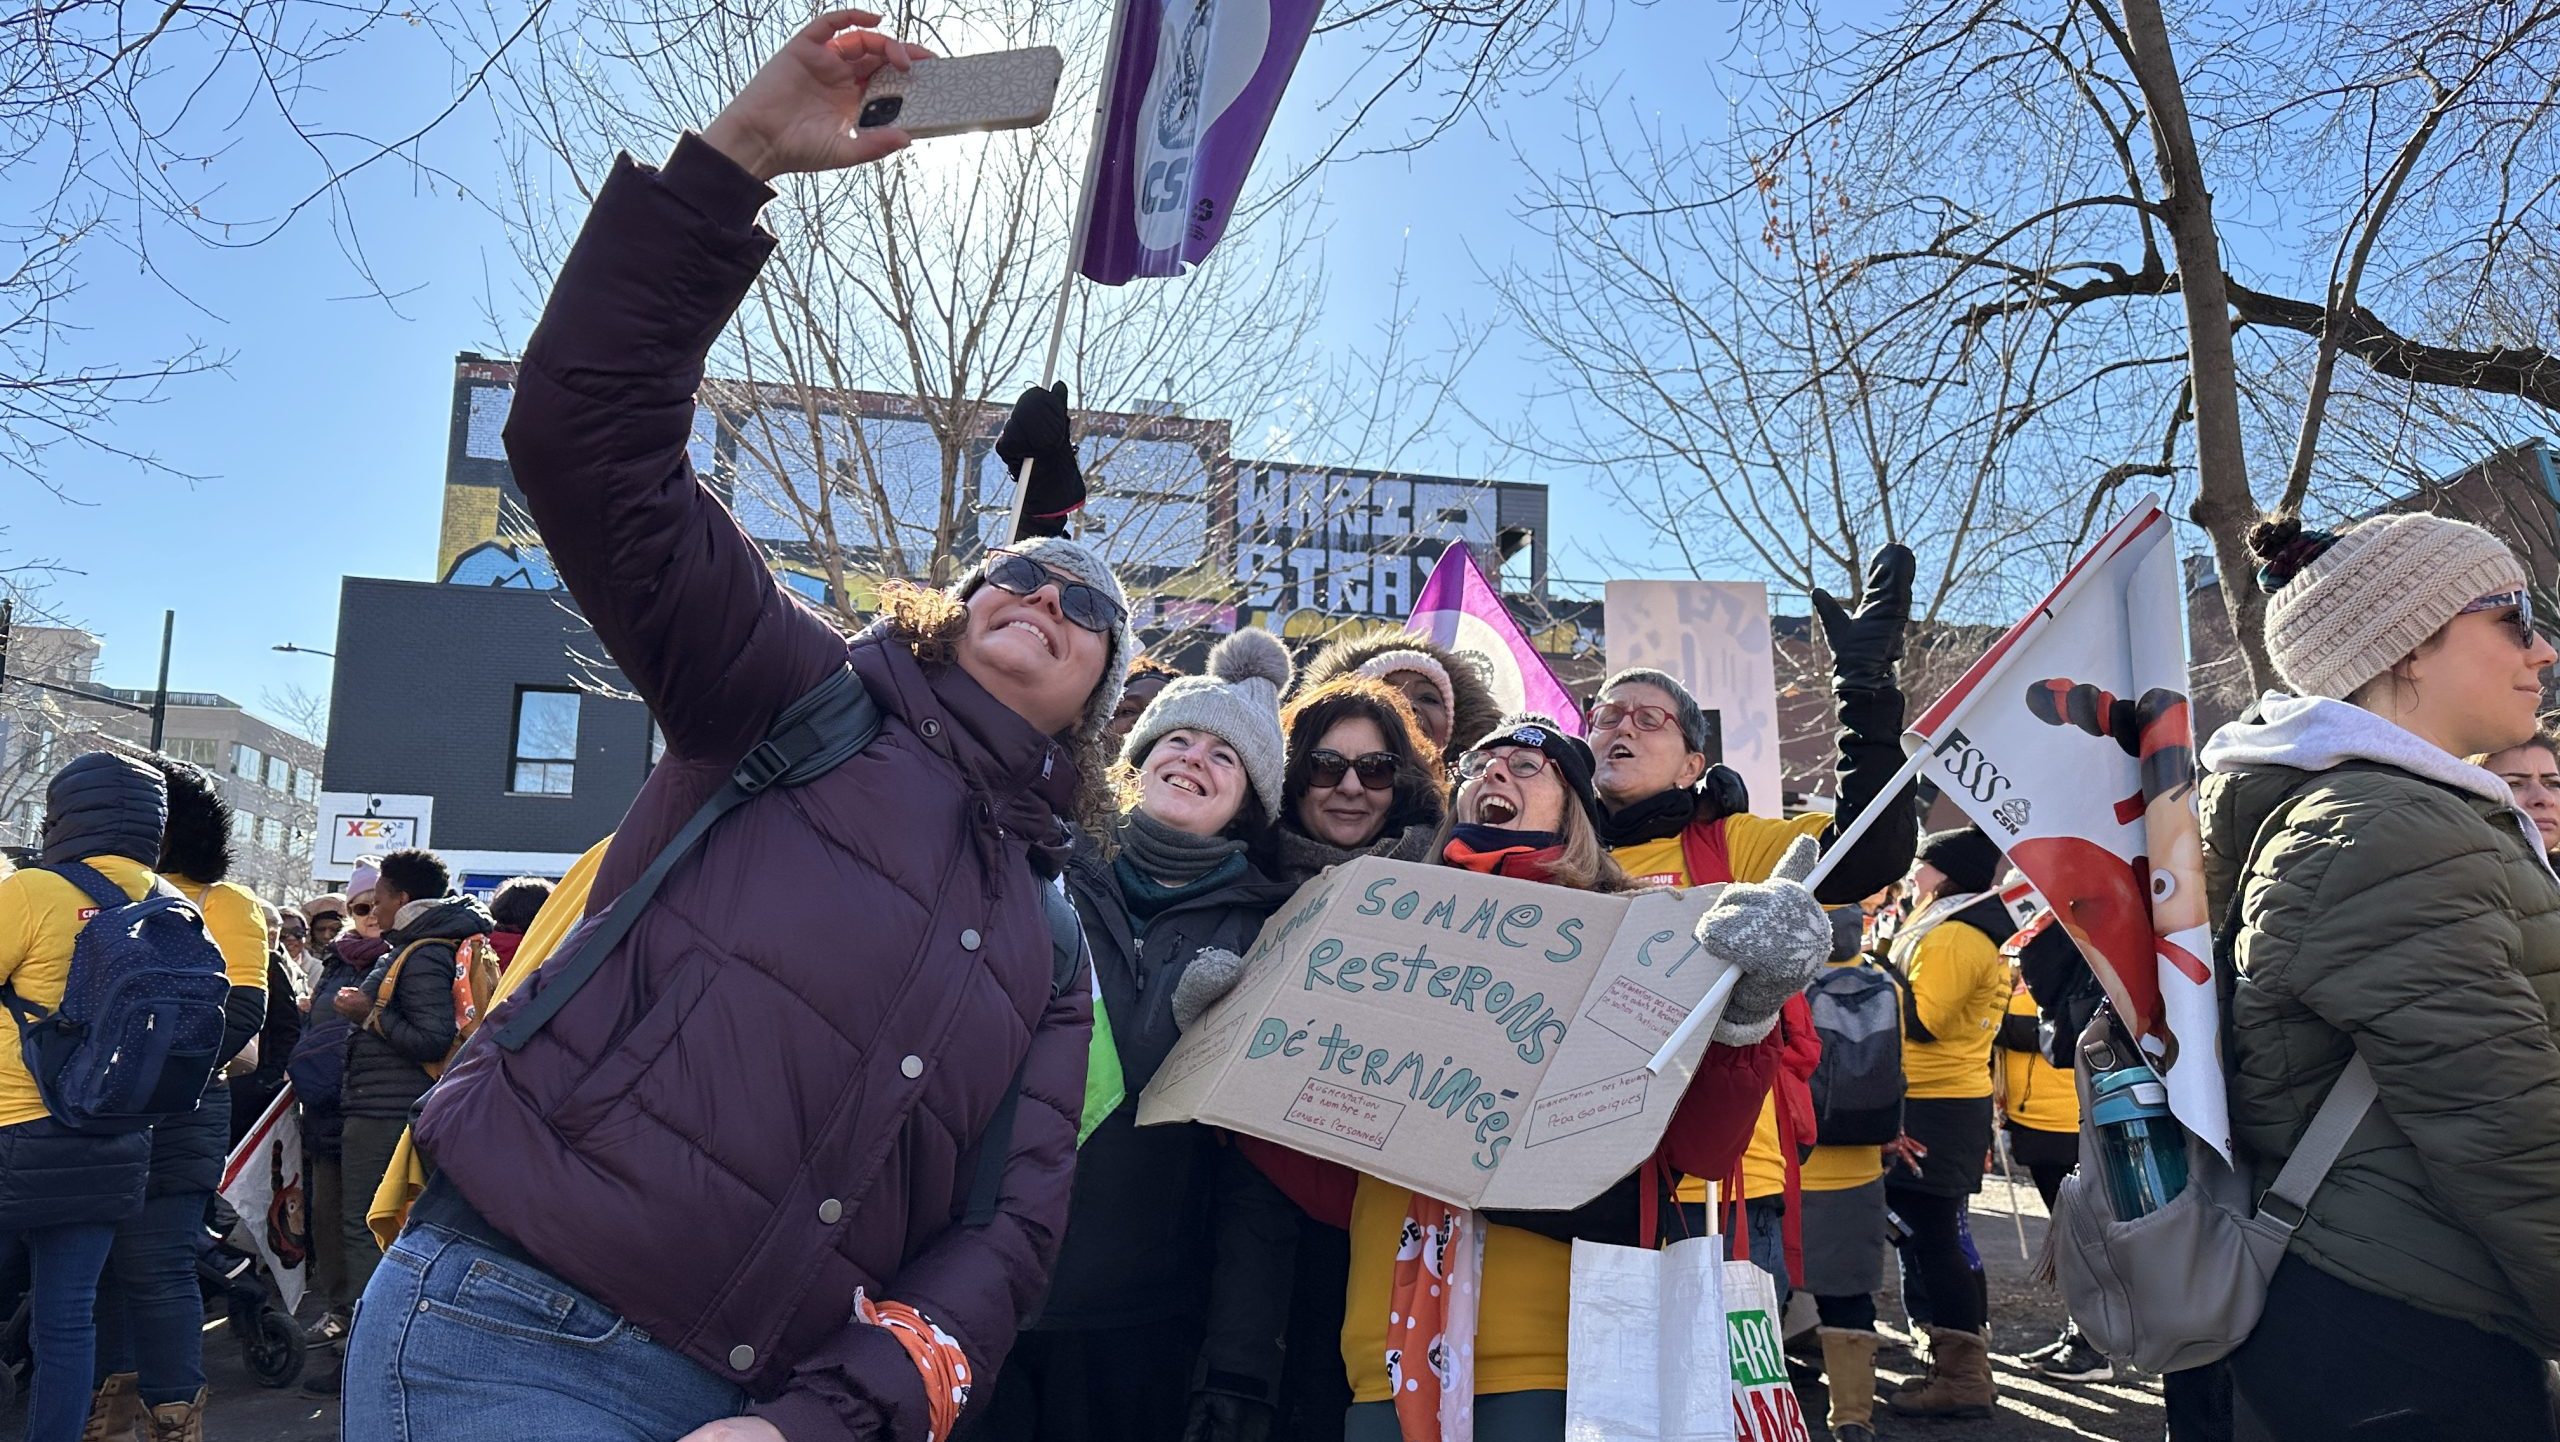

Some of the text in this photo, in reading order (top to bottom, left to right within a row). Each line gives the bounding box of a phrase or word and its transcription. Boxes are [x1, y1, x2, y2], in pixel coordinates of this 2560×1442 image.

[1142, 156, 1190, 215] CS
[1933, 727, 2012, 803] FSSS
[1992, 809, 2020, 836] CSN
